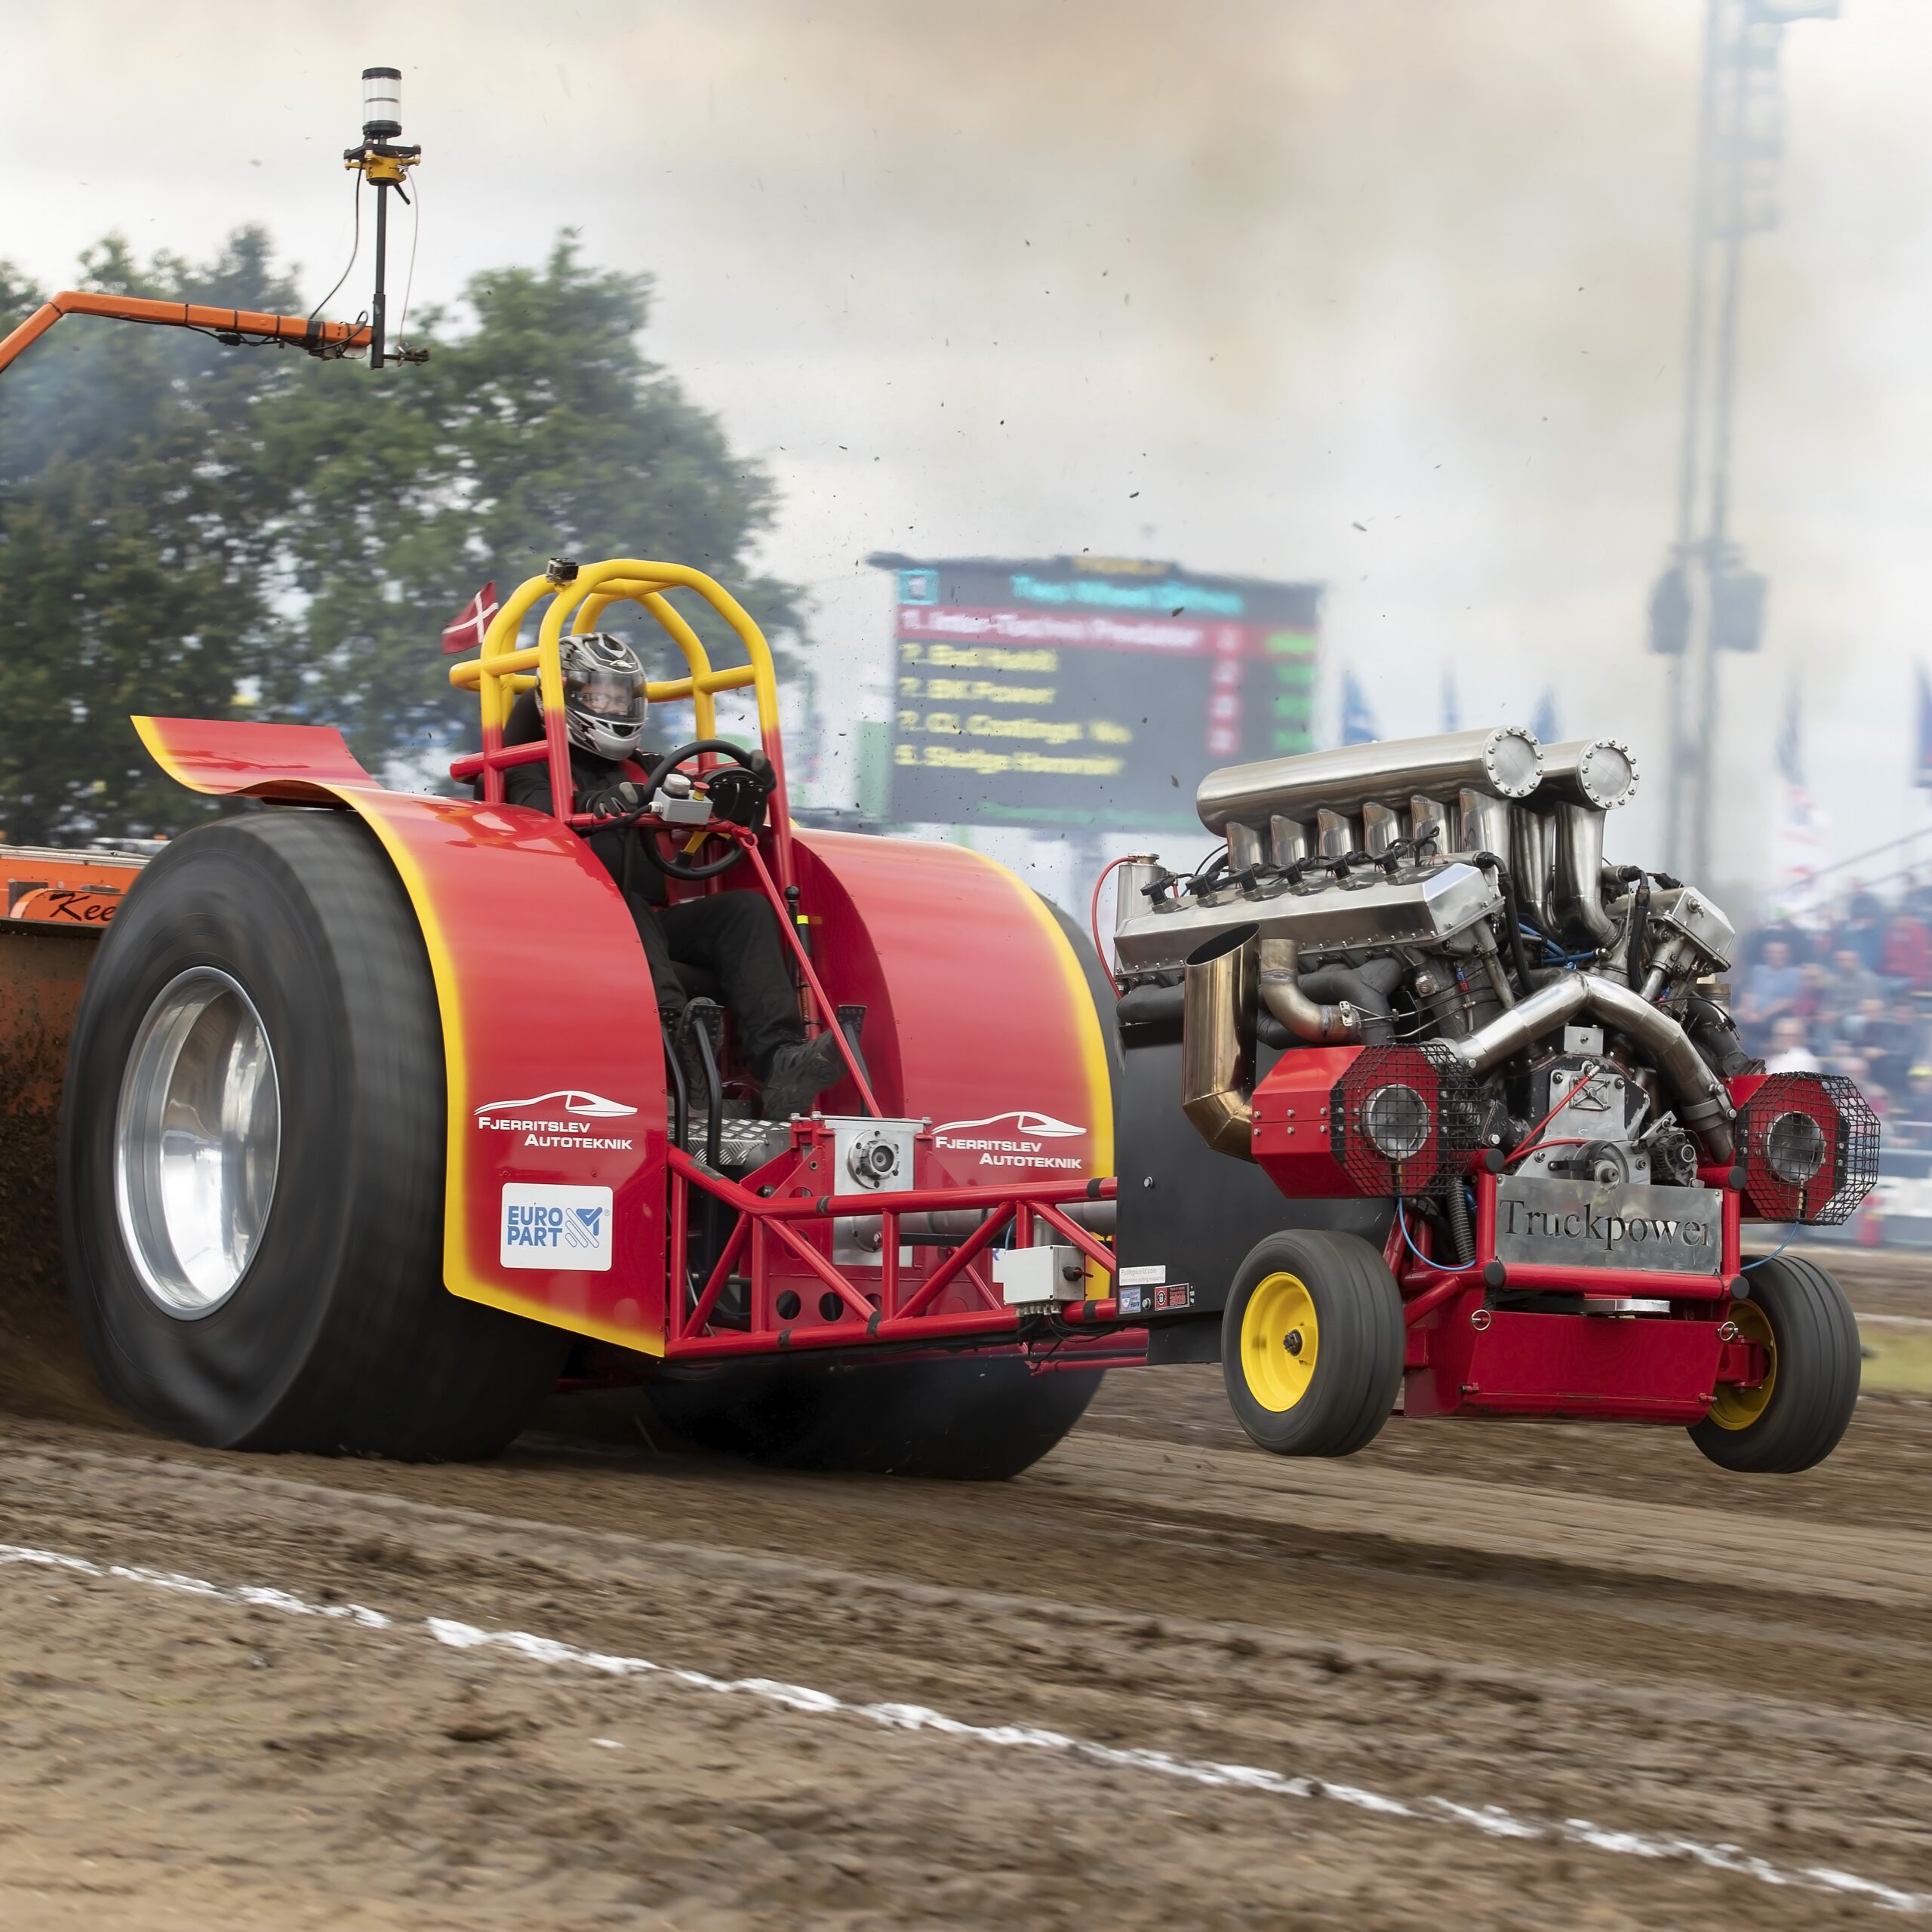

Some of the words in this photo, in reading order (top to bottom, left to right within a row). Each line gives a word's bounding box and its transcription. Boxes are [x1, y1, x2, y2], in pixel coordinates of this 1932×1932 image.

[478, 1116, 590, 1134] FJERRITSLEV
[524, 1134, 633, 1150] AUTOTEKNIK
[935, 1136, 1042, 1152] FJERRITSLEV
[979, 1152, 1082, 1169] AUTOTEKNIK
[507, 1205, 563, 1226] EURO
[1499, 1198, 1715, 1252] Truckpower
[506, 1226, 563, 1247] PART
